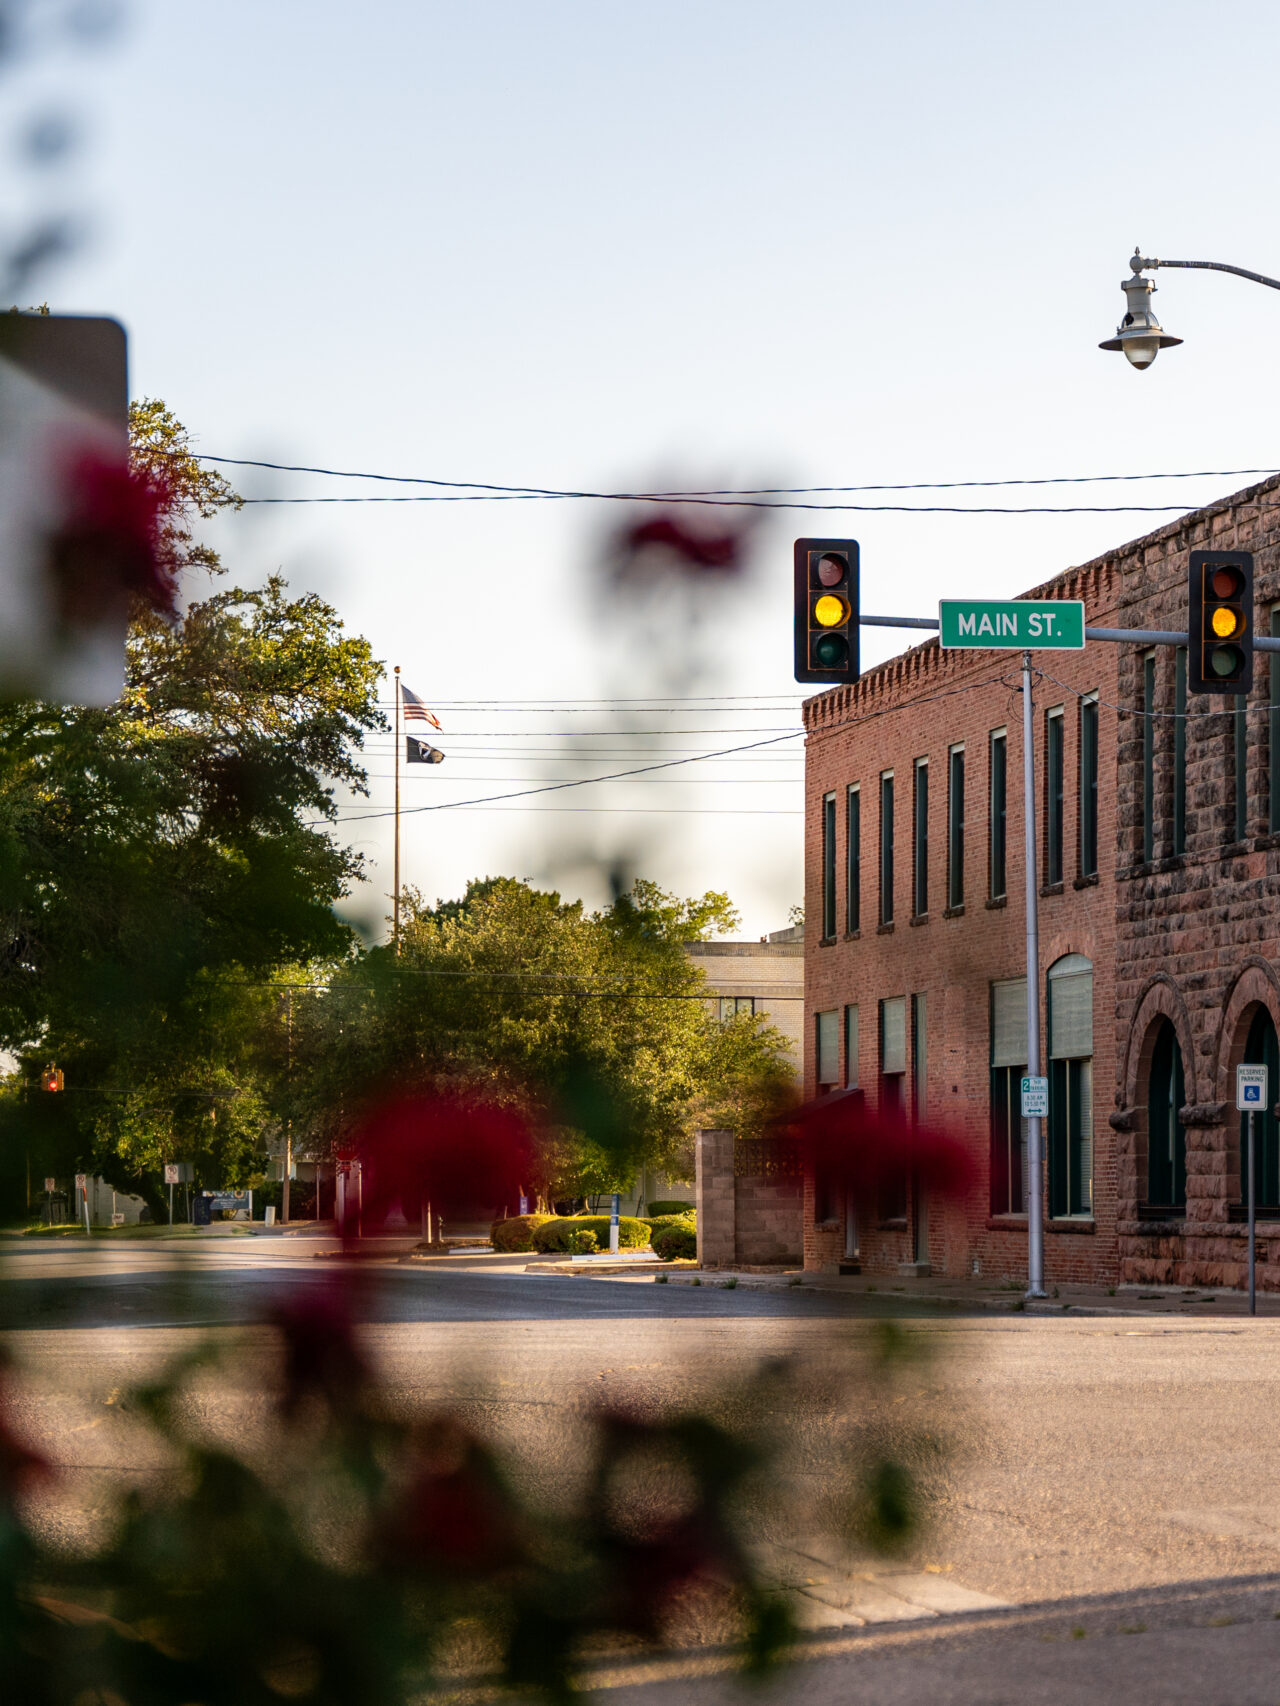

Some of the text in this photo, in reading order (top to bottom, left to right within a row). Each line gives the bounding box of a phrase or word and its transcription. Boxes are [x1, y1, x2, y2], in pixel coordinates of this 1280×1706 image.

[958, 612, 1062, 637] MAIN ST.
[1240, 1068, 1266, 1076] RESERVED
[1023, 1080, 1029, 1091] 2
